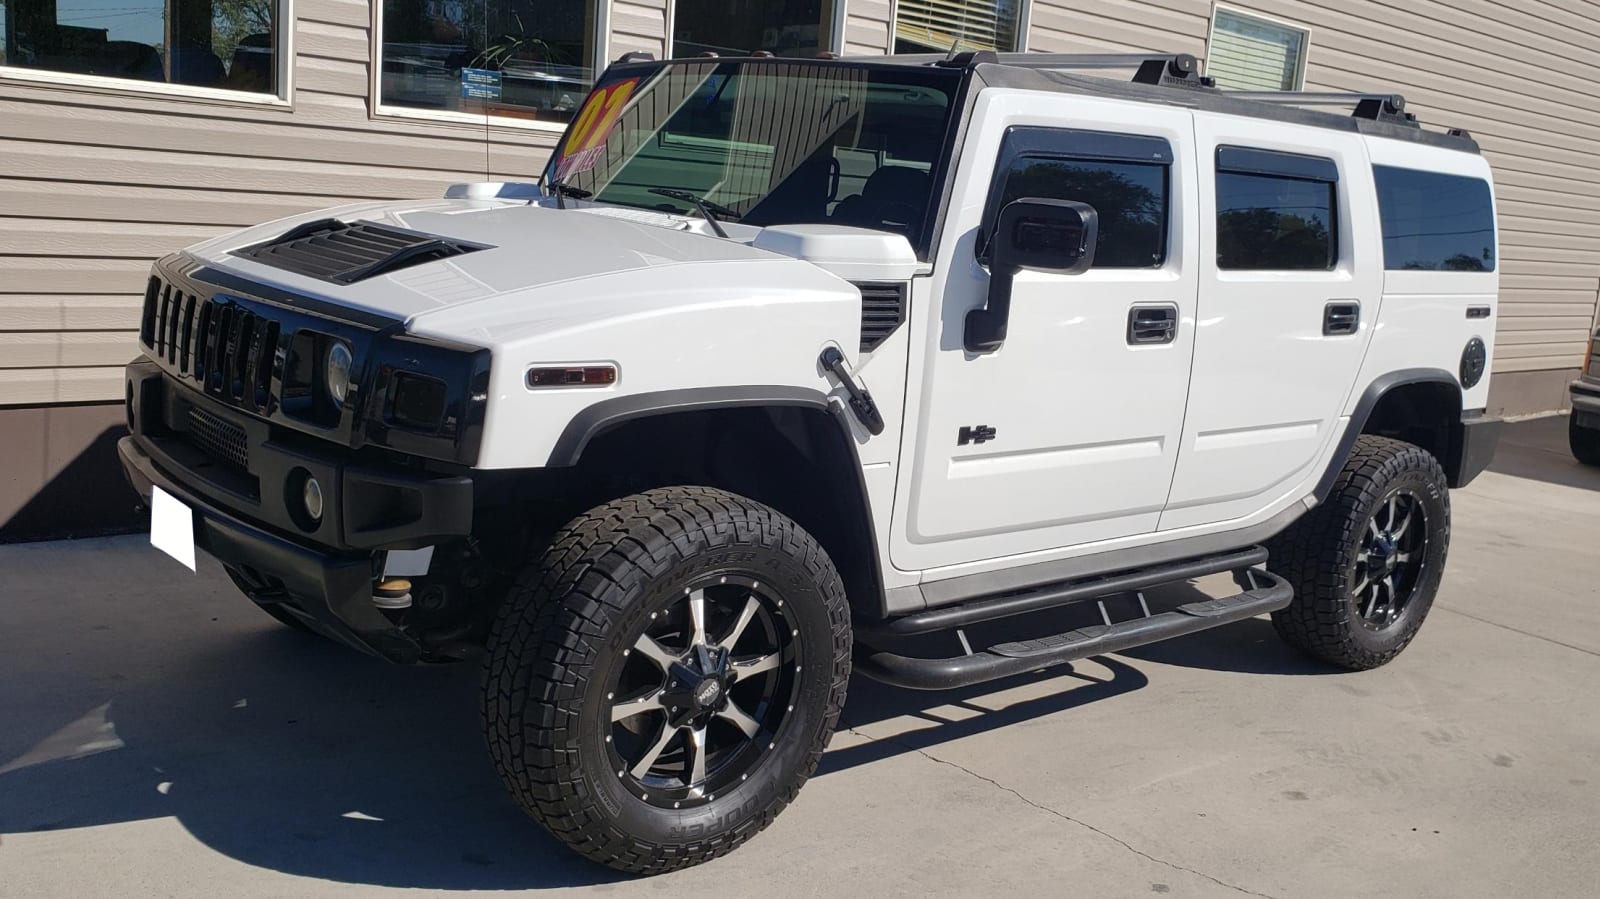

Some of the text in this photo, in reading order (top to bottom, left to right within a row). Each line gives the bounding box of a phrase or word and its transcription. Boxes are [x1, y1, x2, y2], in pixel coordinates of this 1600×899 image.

[563, 80, 636, 157] 07
[957, 424, 997, 447] H2
[668, 781, 776, 840] COOPER
